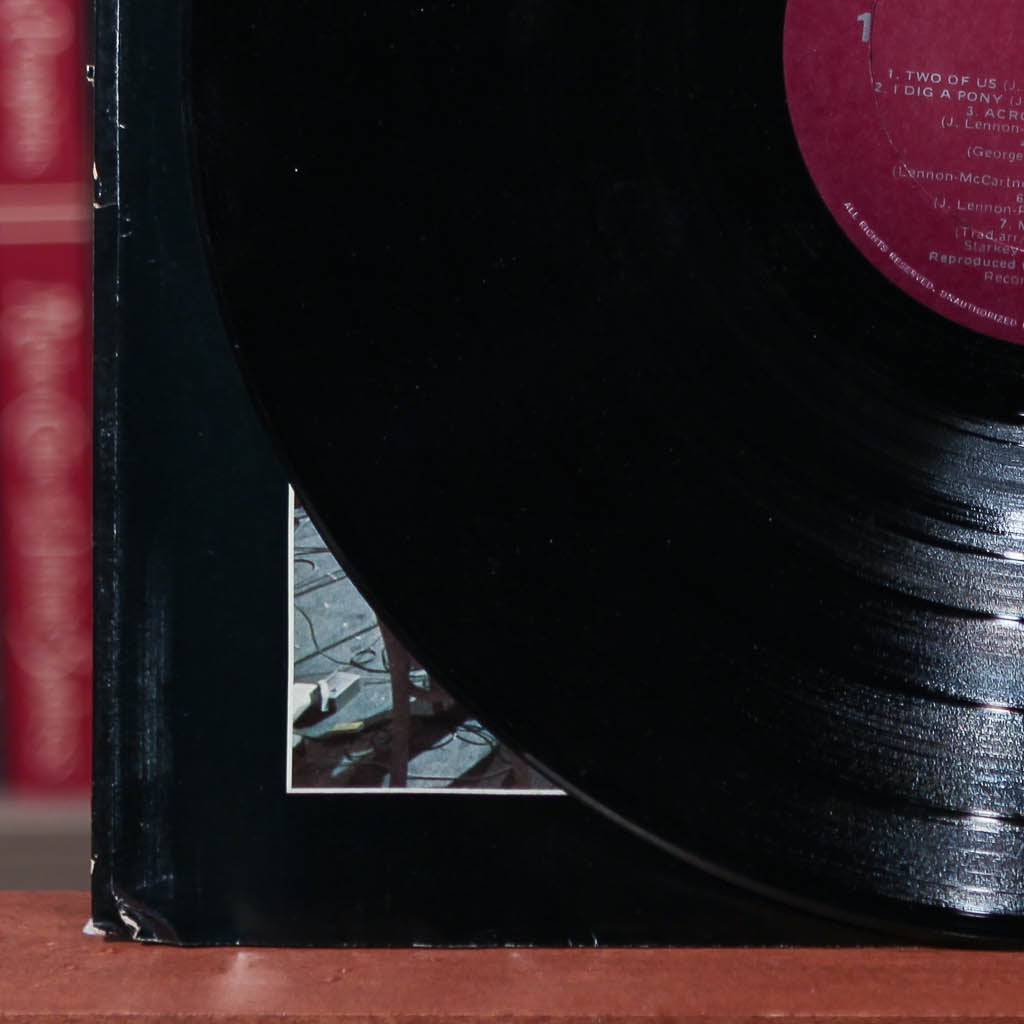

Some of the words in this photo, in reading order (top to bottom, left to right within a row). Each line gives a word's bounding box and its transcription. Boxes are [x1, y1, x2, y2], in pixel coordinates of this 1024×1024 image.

[856, 12, 872, 42] 1
[888, 68, 900, 80] 1.
[906, 70, 942, 84] TWO
[947, 74, 970, 86] OF
[976, 77, 997, 90] US
[872, 81, 888, 94] 2.
[893, 83, 898, 94] I
[904, 85, 934, 98] DIG
[940, 88, 951, 99] A
[957, 91, 1003, 105] PONY
[941, 116, 959, 129] (J.
[967, 145, 1023, 163] (George
[933, 196, 951, 209] (J.
[843, 202, 859, 220] ALL
[858, 220, 889, 253] RIGHTS
[938, 289, 1018, 327] UNAUTHORIZED
[929, 251, 1016, 270] Reproduced
